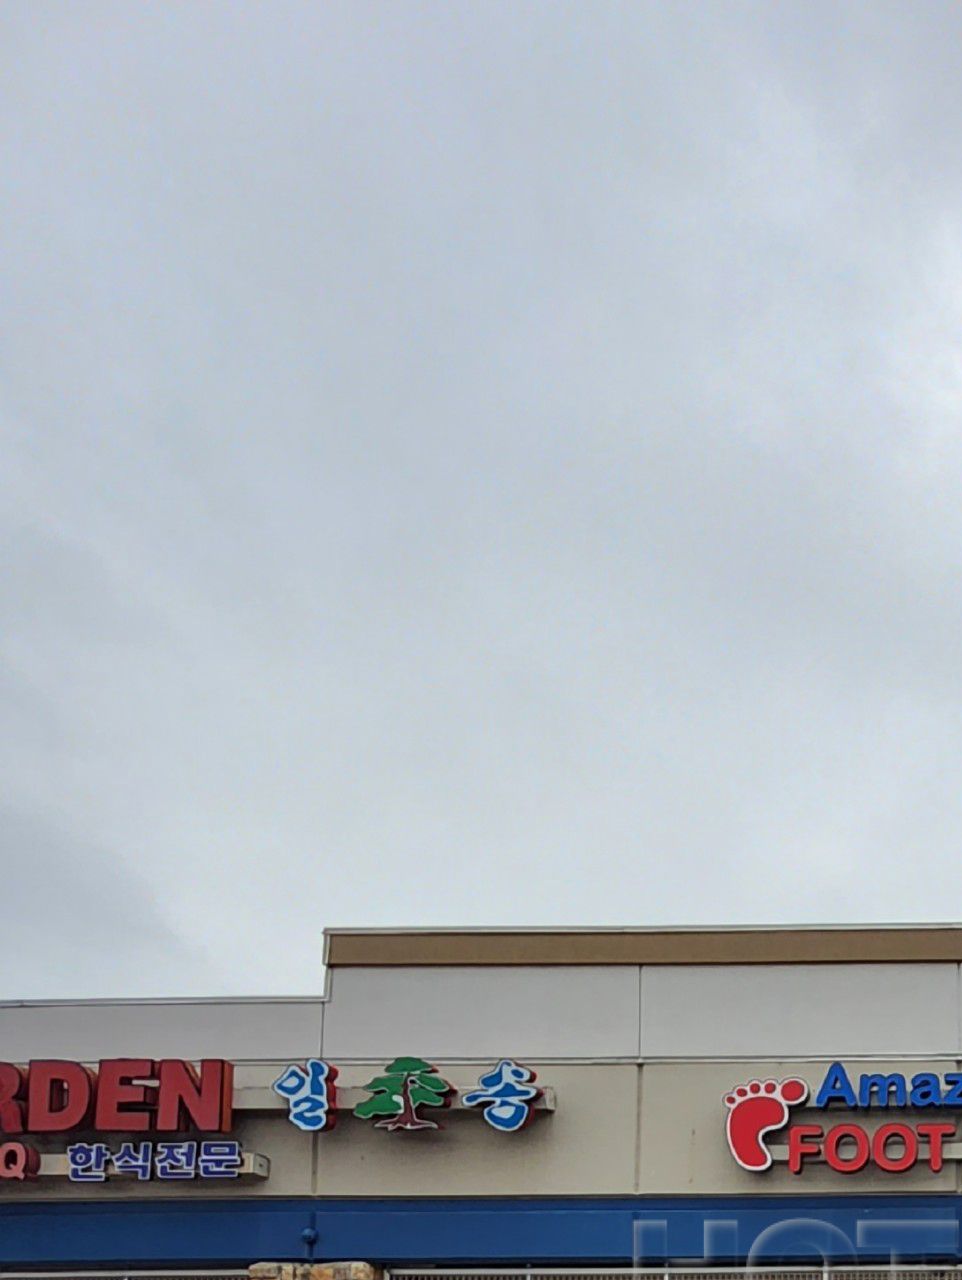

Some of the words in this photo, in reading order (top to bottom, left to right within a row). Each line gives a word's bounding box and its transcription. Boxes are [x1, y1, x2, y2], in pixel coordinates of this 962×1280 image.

[272, 1058, 334, 1131] 일
[462, 1059, 540, 1131] 송
[67, 1141, 242, 1182] 한식전문
[788, 1123, 956, 1173] FOOT
